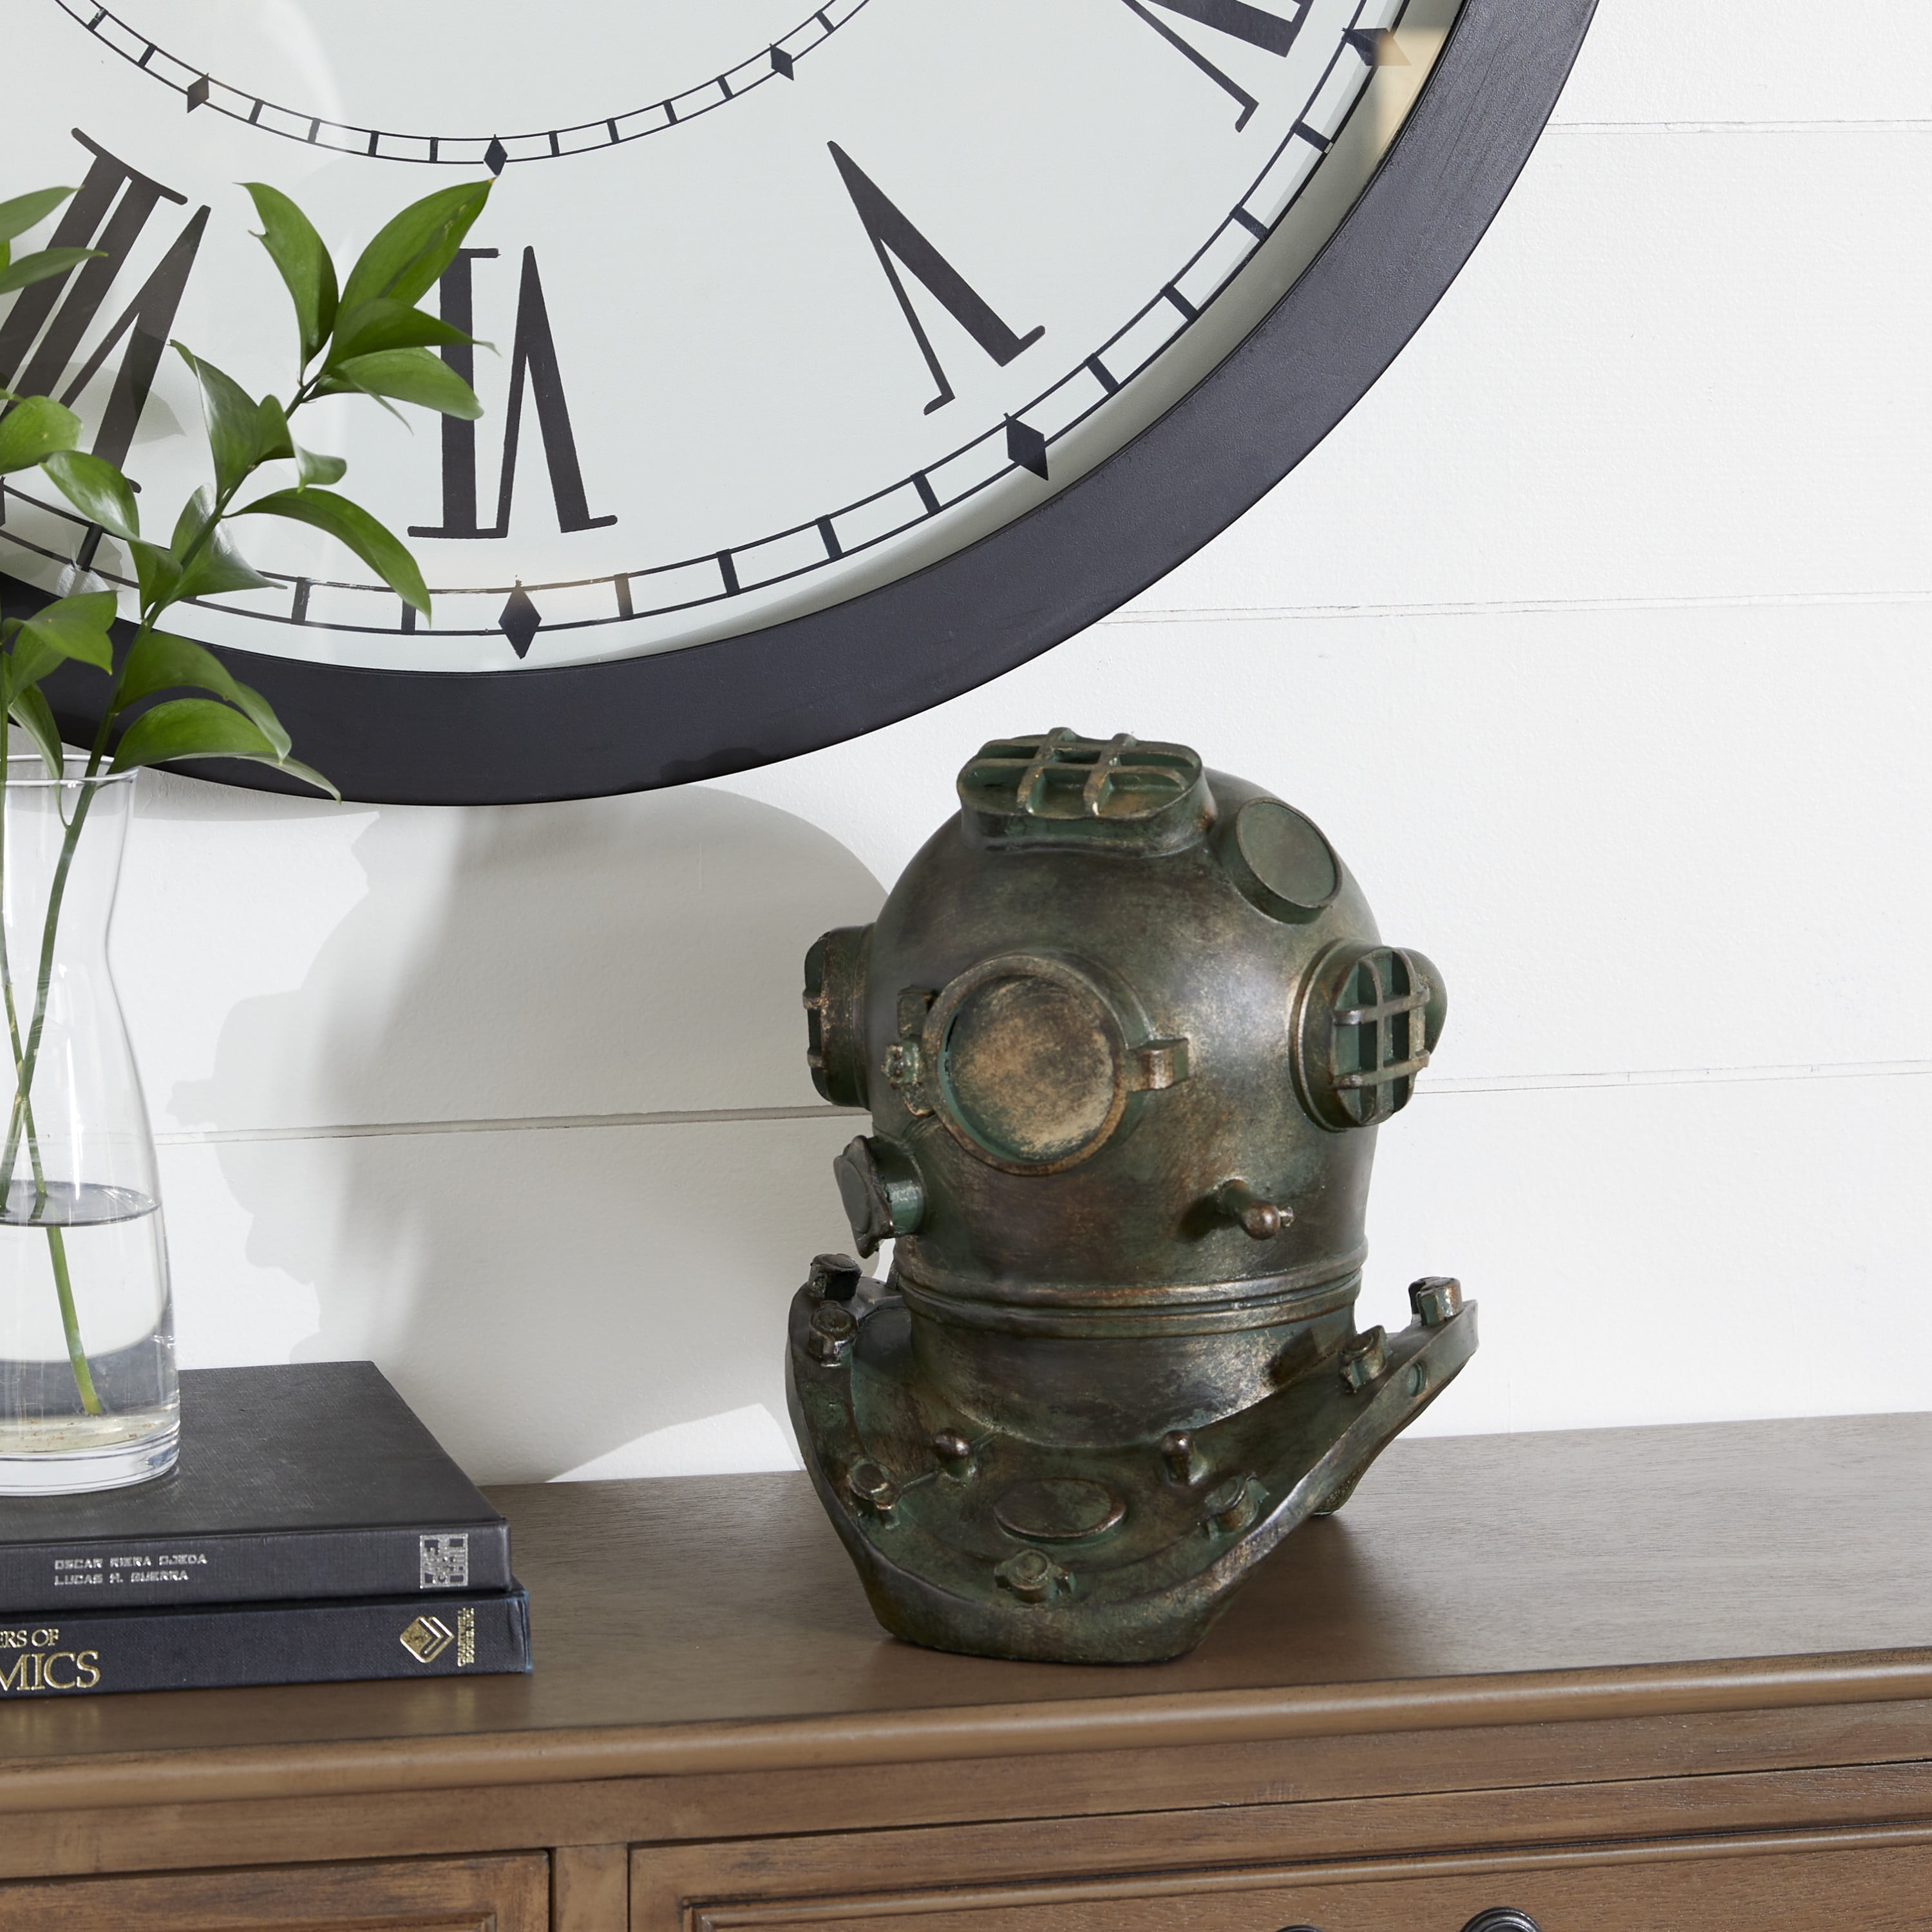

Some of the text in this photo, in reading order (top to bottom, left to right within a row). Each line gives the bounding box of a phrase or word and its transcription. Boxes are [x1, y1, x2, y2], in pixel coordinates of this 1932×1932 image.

[54, 1553, 208, 1571] OSCAR RIERA OJEDA
[54, 1573, 104, 1586] LUCAS
[130, 1569, 189, 1583] GUERRA
[31, 1628, 59, 1647] OF
